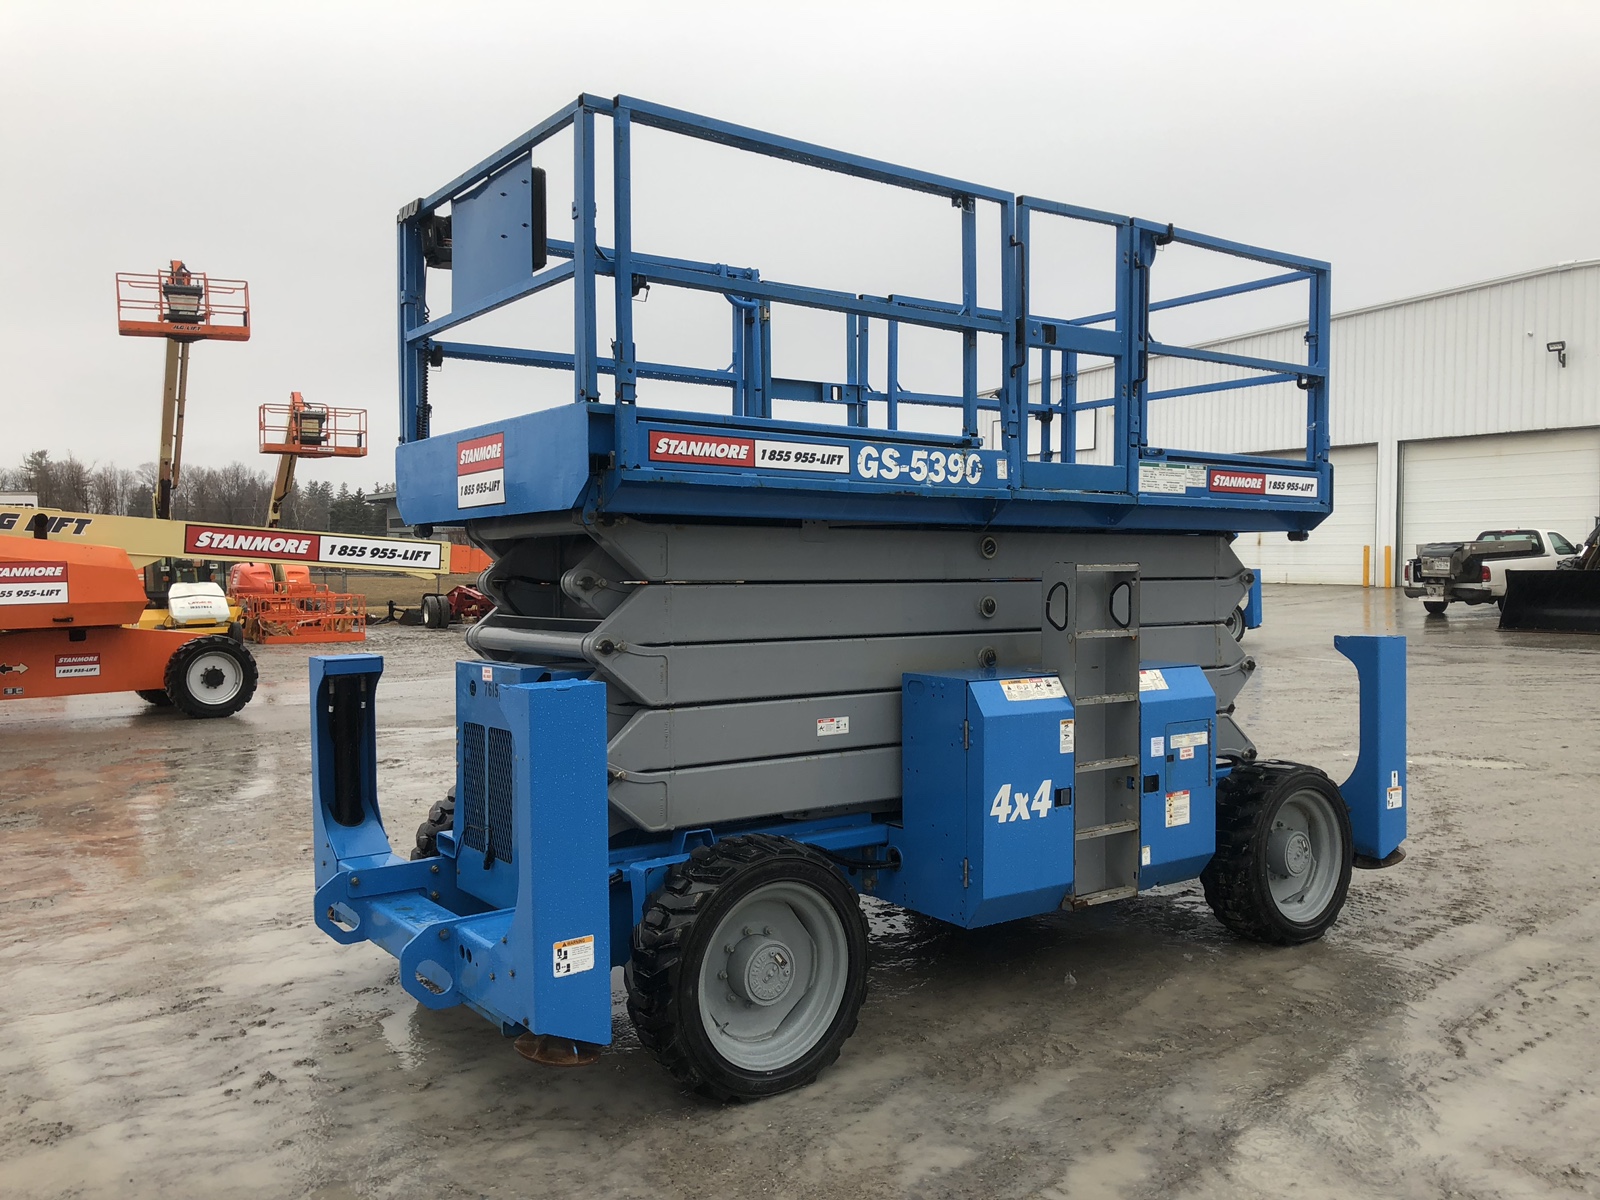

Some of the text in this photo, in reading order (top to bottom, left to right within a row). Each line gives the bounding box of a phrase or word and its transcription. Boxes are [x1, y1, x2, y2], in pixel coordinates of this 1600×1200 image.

[460, 443, 502, 465] STANMORE
[655, 438, 844, 465] STANMORE 1 855 955-LIFT
[857, 445, 982, 485] GS-5390
[463, 484, 475, 495] 855
[476, 480, 500, 494] 955-LIFT
[1212, 474, 1263, 489] STANMORE
[1272, 481, 1286, 490] 855
[1286, 482, 1314, 492] 955-LIFT
[195, 531, 431, 561] STANMORE 1 855 955-LIFT
[16, 589, 61, 597] 955-LIFT
[990, 779, 1052, 823] 4x4
